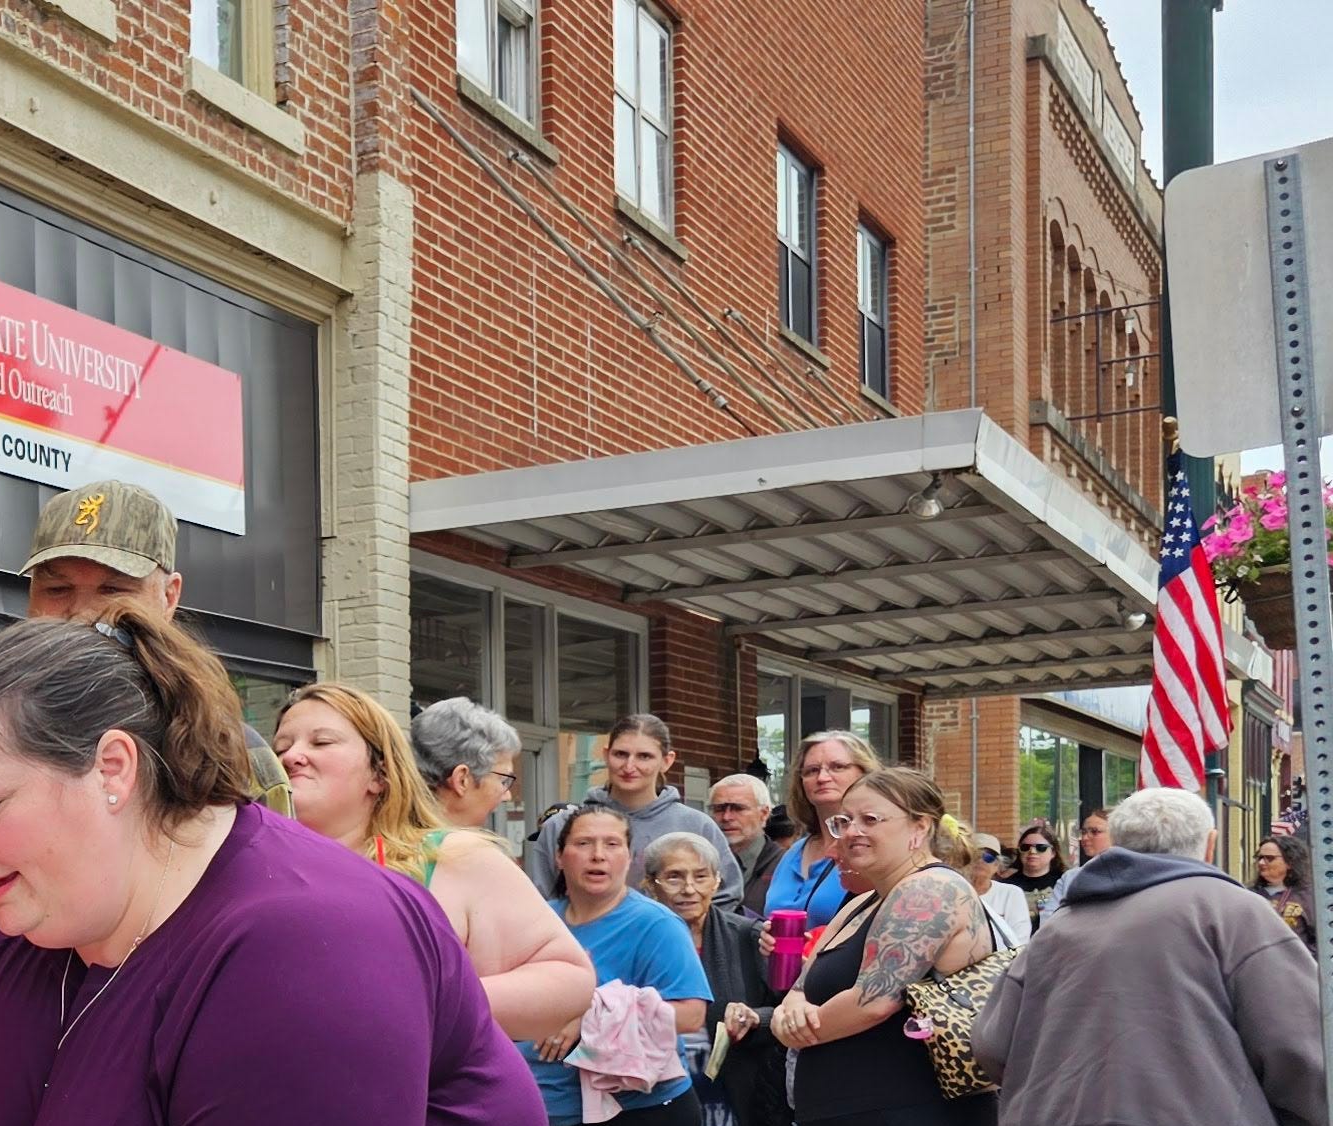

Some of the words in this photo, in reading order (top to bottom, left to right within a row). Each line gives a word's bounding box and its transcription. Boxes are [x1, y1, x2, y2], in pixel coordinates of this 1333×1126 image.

[31, 319, 144, 400] UNIVERSITY
[8, 368, 74, 417] Outreach
[2, 433, 73, 473] COUNTY
